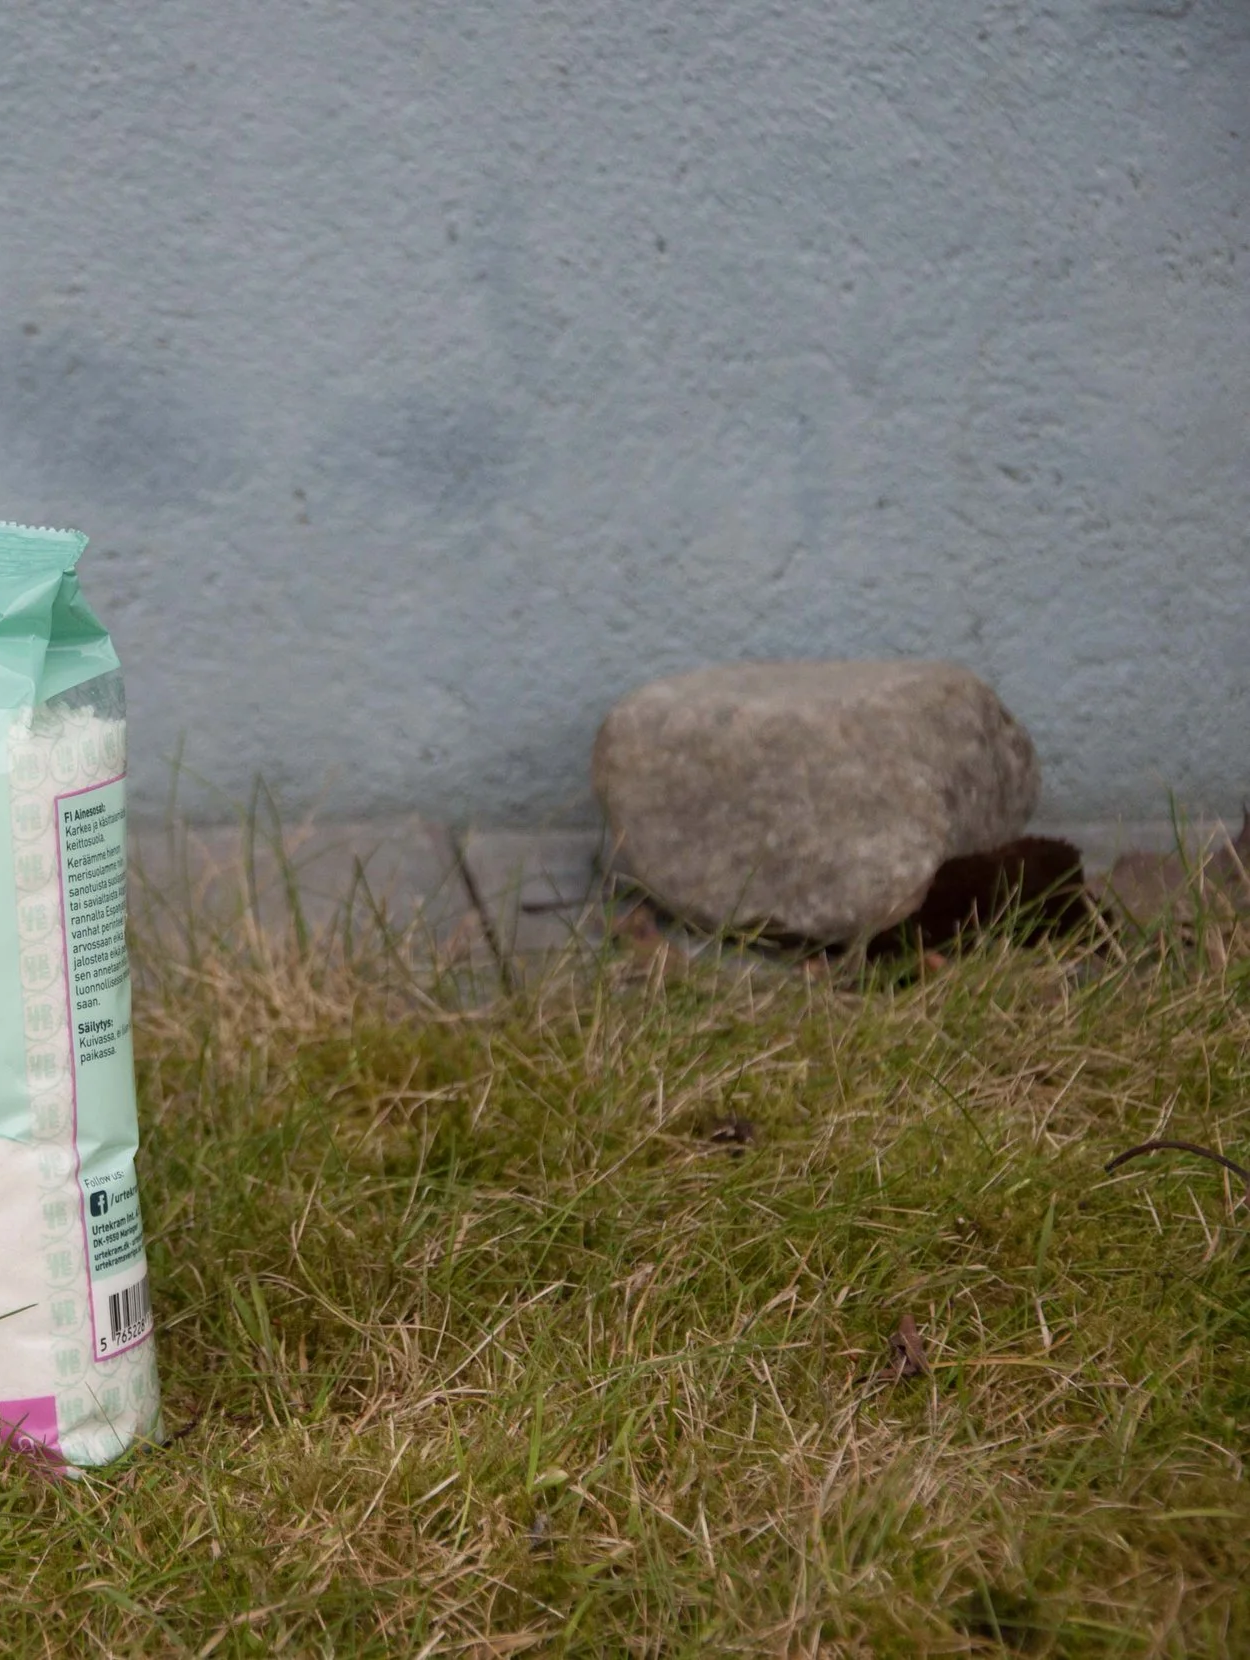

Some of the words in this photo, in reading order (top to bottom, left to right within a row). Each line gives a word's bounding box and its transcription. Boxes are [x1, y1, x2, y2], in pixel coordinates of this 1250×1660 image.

[65, 823, 91, 837] Karkea
[67, 850, 106, 869] Keräämme
[69, 880, 107, 898] sanotuista
[70, 899, 81, 911] tai
[71, 909, 104, 925] rannalta
[71, 924, 100, 939] vanhat
[73, 936, 112, 954] arvossaan
[73, 952, 108, 971] jalosteta
[74, 971, 91, 982] sen
[76, 998, 100, 1010] saan.
[78, 1019, 113, 1034] Säilytys:
[84, 1175, 111, 1188] Follow
[92, 1217, 126, 1236] Urtekram
[100, 1337, 107, 1352] 5
